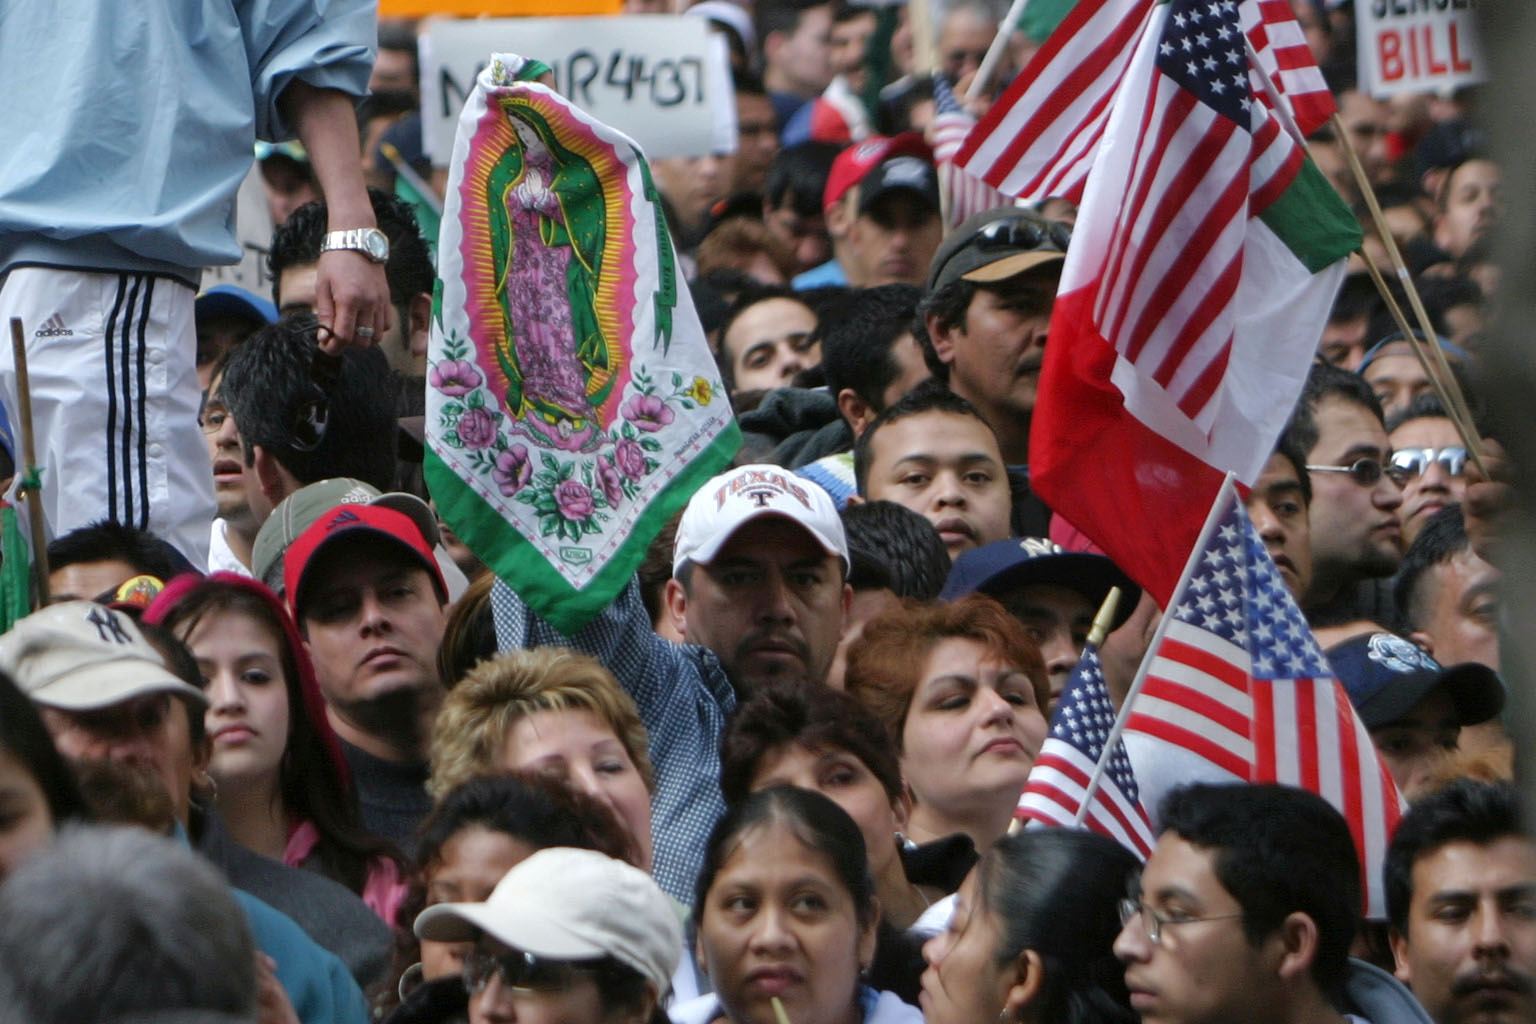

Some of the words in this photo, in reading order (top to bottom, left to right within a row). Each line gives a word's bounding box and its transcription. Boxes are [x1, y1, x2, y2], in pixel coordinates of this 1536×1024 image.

[1376, 22, 1472, 82] BILL
[550, 48, 704, 108] R4437
[35, 327, 73, 337] adidas
[715, 471, 814, 512] TEXAS
[747, 490, 778, 508] T
[85, 607, 133, 644] NY
